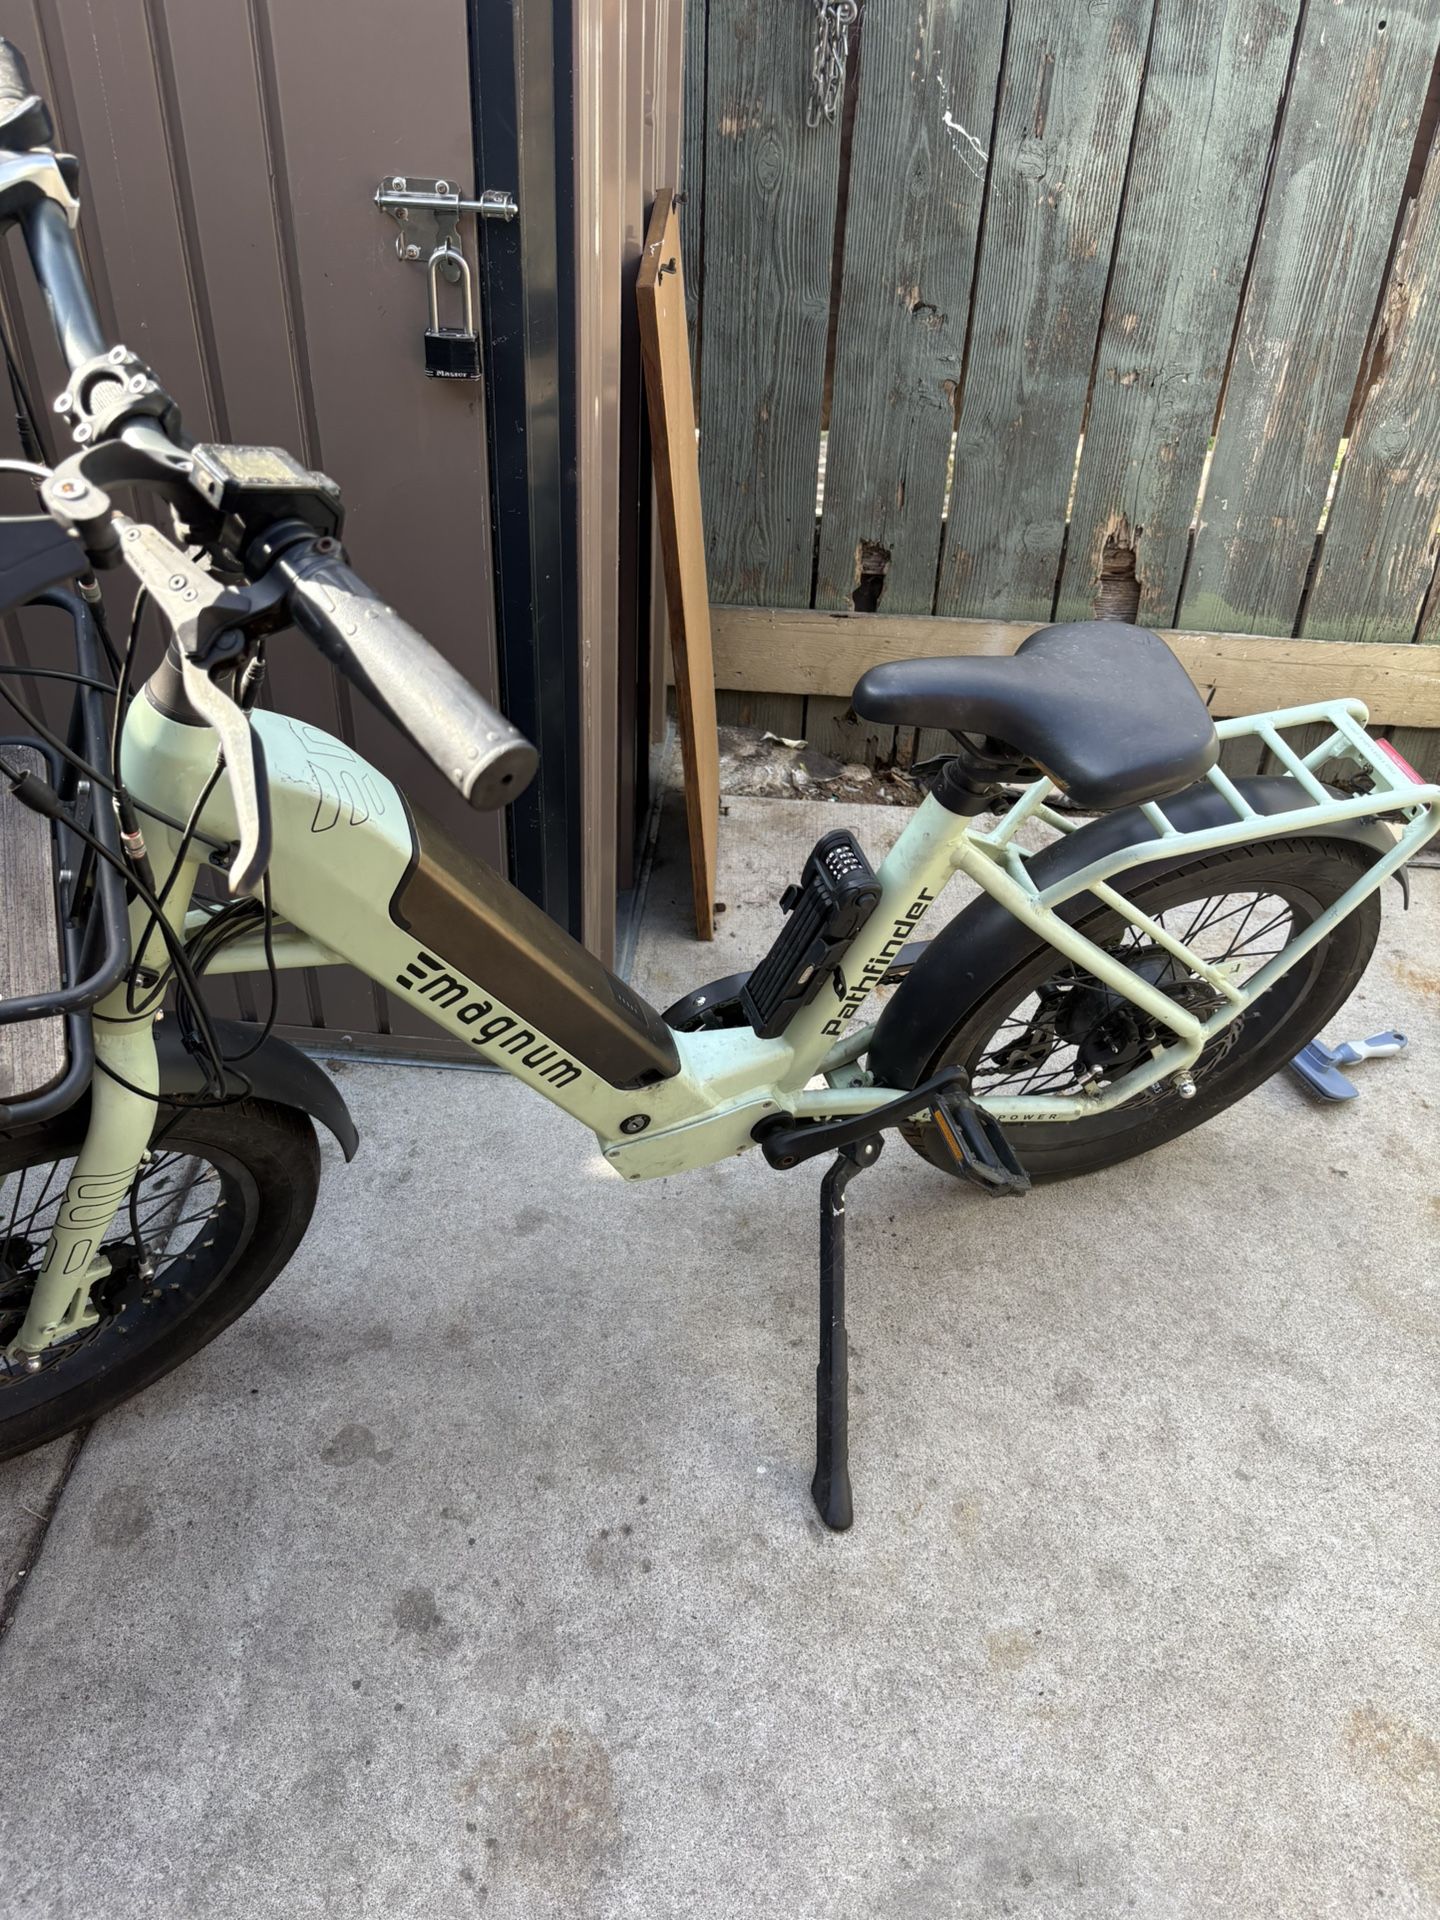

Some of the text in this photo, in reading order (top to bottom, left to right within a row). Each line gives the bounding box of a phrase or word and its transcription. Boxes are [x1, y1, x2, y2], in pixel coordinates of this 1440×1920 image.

[436, 370, 468, 378] Master
[821, 887, 935, 1036] Pathfinder
[417, 973, 582, 1088] magnum
[997, 1113, 1058, 1121] POWER
